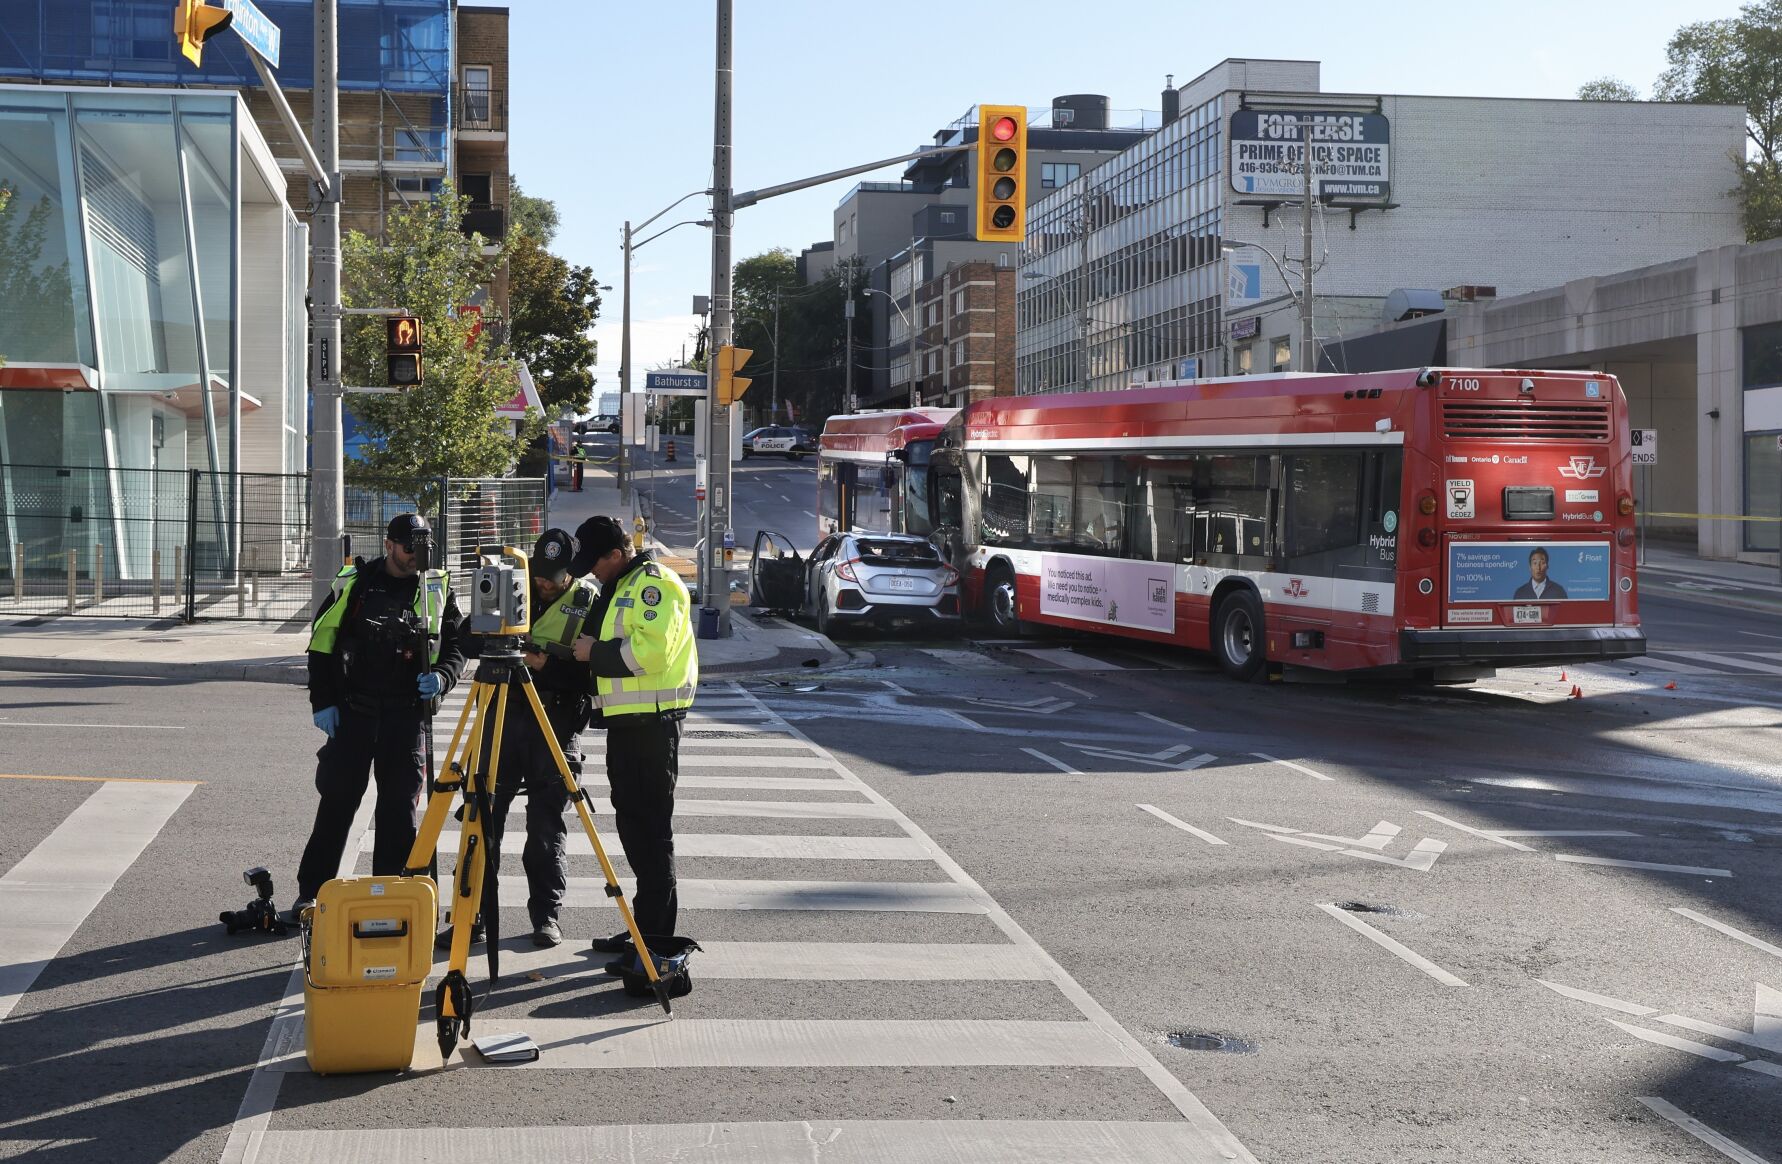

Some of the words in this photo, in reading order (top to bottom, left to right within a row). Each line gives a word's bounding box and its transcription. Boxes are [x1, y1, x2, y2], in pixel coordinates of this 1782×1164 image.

[1257, 114, 1298, 139] FOR
[1307, 116, 1364, 141] EASE
[1239, 144, 1283, 160] PRIME
[1287, 146, 1334, 162] OFICE
[1337, 147, 1381, 163] SPACE
[1256, 178, 1305, 187] TVMGRO
[1324, 184, 1380, 194] www.tvm.ca
[654, 376, 691, 388] Bathurst
[1450, 379, 1480, 391] 7100
[1632, 453, 1655, 462] ENDS
[1369, 534, 1396, 549] Hybrid
[1380, 548, 1395, 561] Bus
[1467, 553, 1491, 561] savings
[1456, 560, 1484, 568] business
[1485, 560, 1518, 569] spending?
[1047, 567, 1057, 578] You
[1057, 569, 1076, 580] noticed
[1075, 570, 1085, 581] this
[1466, 574, 1484, 582] 100%
[1047, 579, 1056, 590] We
[1056, 581, 1069, 591] need
[1068, 584, 1079, 594] you
[1078, 583, 1084, 593] to
[1083, 584, 1099, 595] notice
[1047, 592, 1070, 606] medically
[1070, 595, 1092, 607] complex
[1091, 596, 1104, 608] kids.
[561, 604, 587, 617] POLICE
